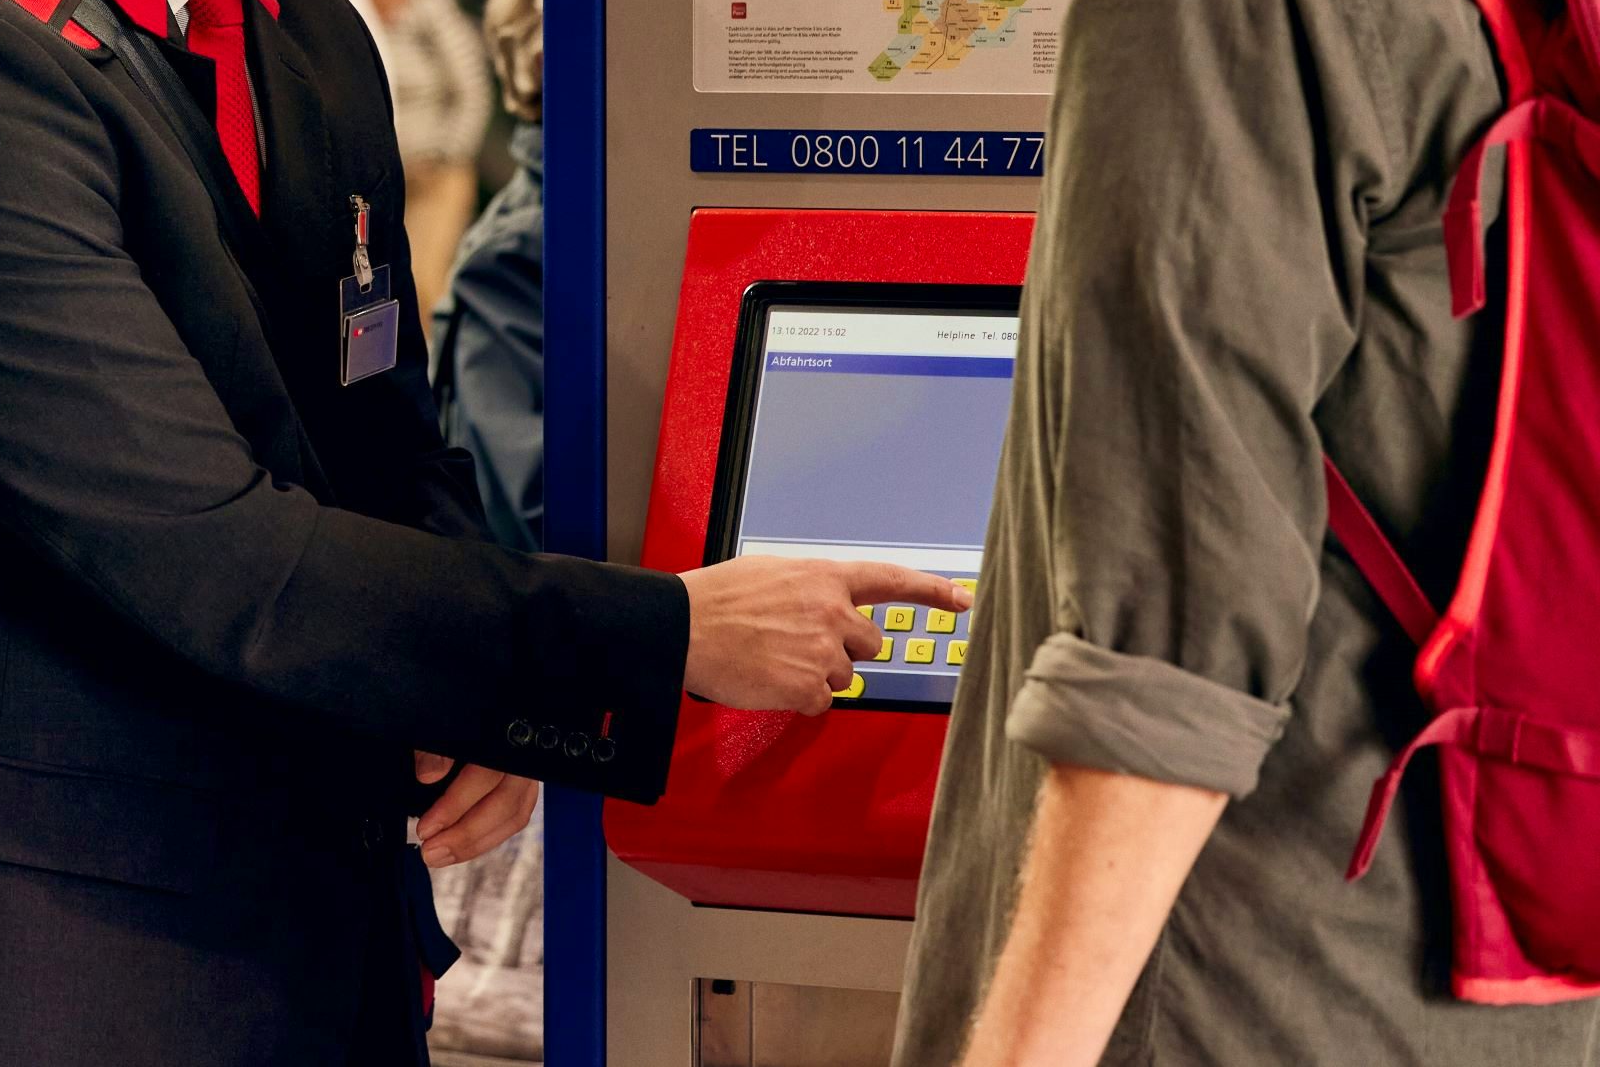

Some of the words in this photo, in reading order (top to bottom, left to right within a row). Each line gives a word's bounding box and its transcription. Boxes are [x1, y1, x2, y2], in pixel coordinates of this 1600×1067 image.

[710, 134, 768, 167] TEL
[791, 134, 879, 169] 0800
[896, 136, 924, 169] 11
[943, 137, 989, 170] 44
[1002, 137, 1045, 171] 77
[822, 327, 846, 337] 15:02
[937, 330, 976, 341] Helpline
[982, 331, 998, 340] Tel.
[770, 355, 833, 368] Abfahrtsort
[895, 613, 905, 624] D
[938, 615, 945, 625] F
[916, 645, 925, 656] C
[958, 647, 968, 657] V
